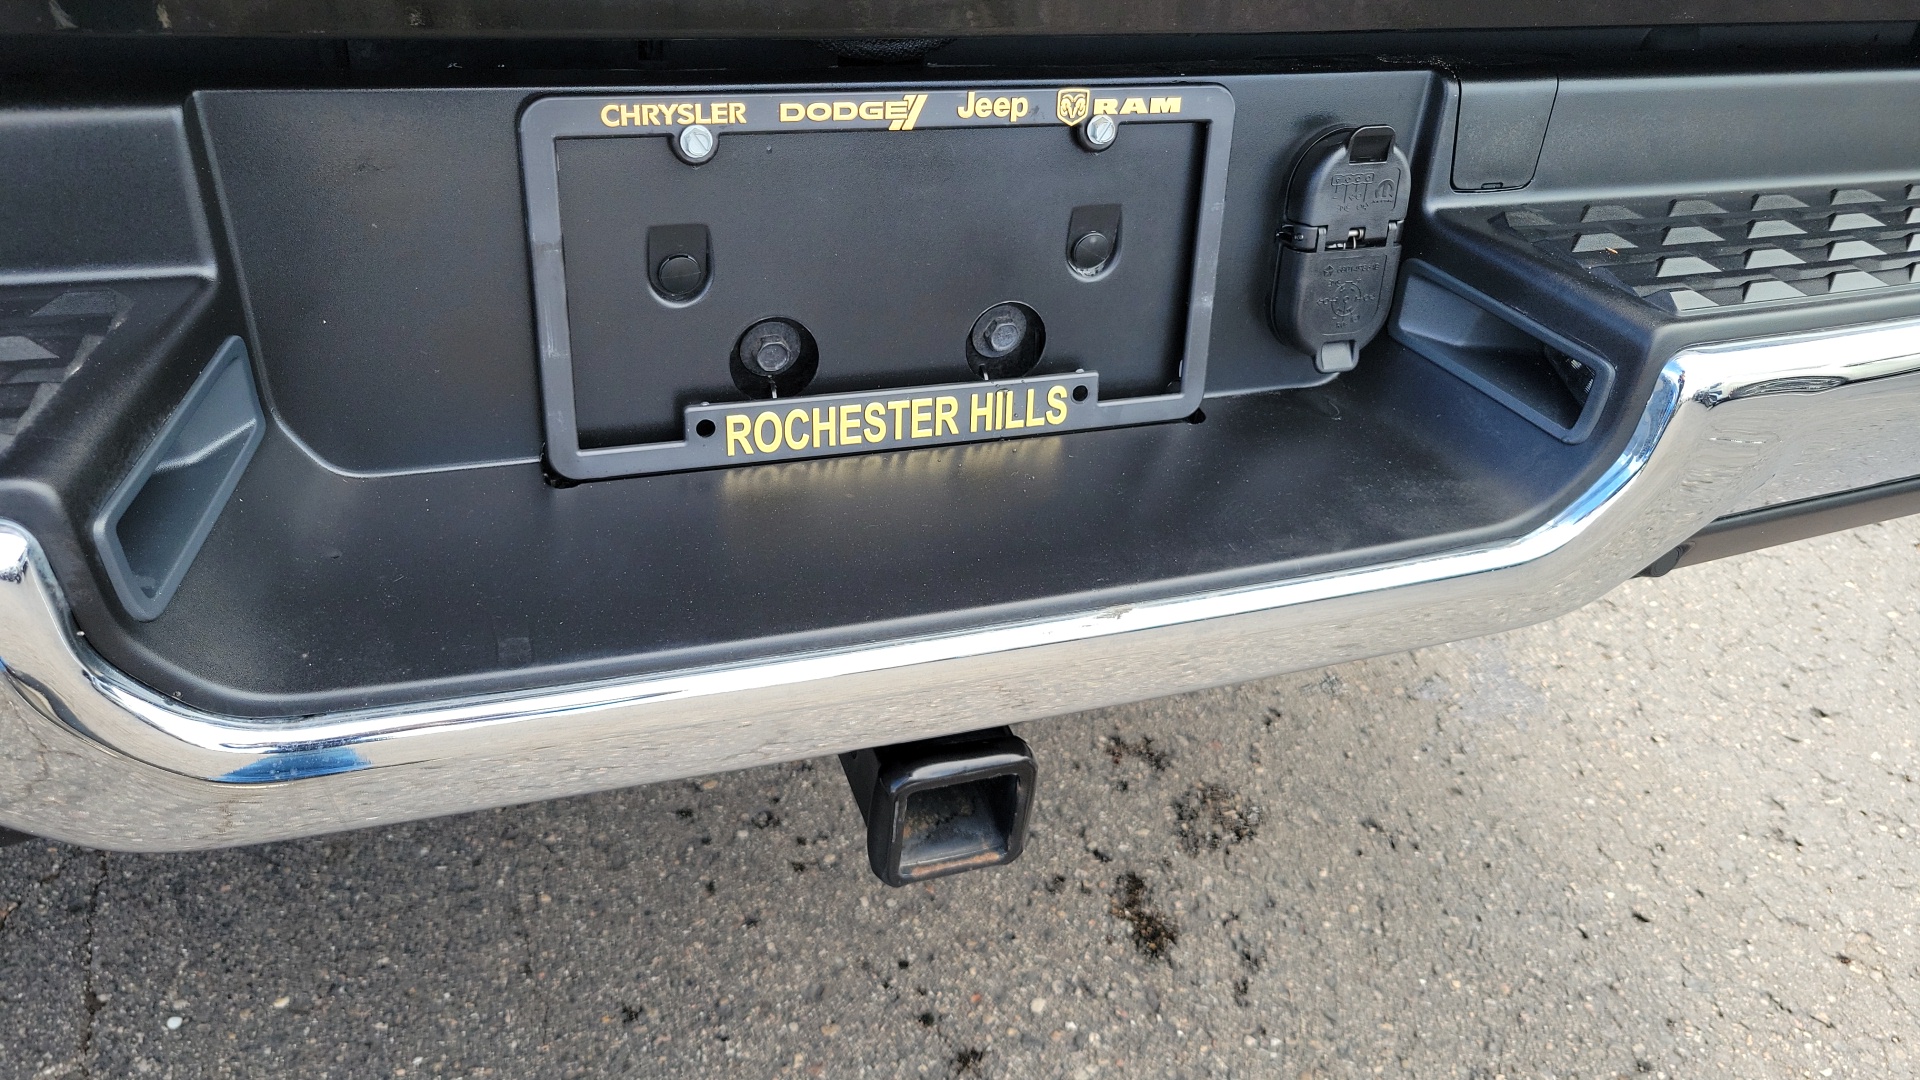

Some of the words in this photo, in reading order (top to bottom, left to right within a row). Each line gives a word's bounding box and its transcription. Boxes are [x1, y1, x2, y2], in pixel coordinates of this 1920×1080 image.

[600, 102, 747, 128] CHRYSLER
[779, 101, 909, 122] DODGE
[957, 91, 1029, 122] Jeep
[1093, 97, 1181, 115] RAM
[725, 396, 959, 457] ROCHESTER
[970, 385, 1068, 433] HILLS
